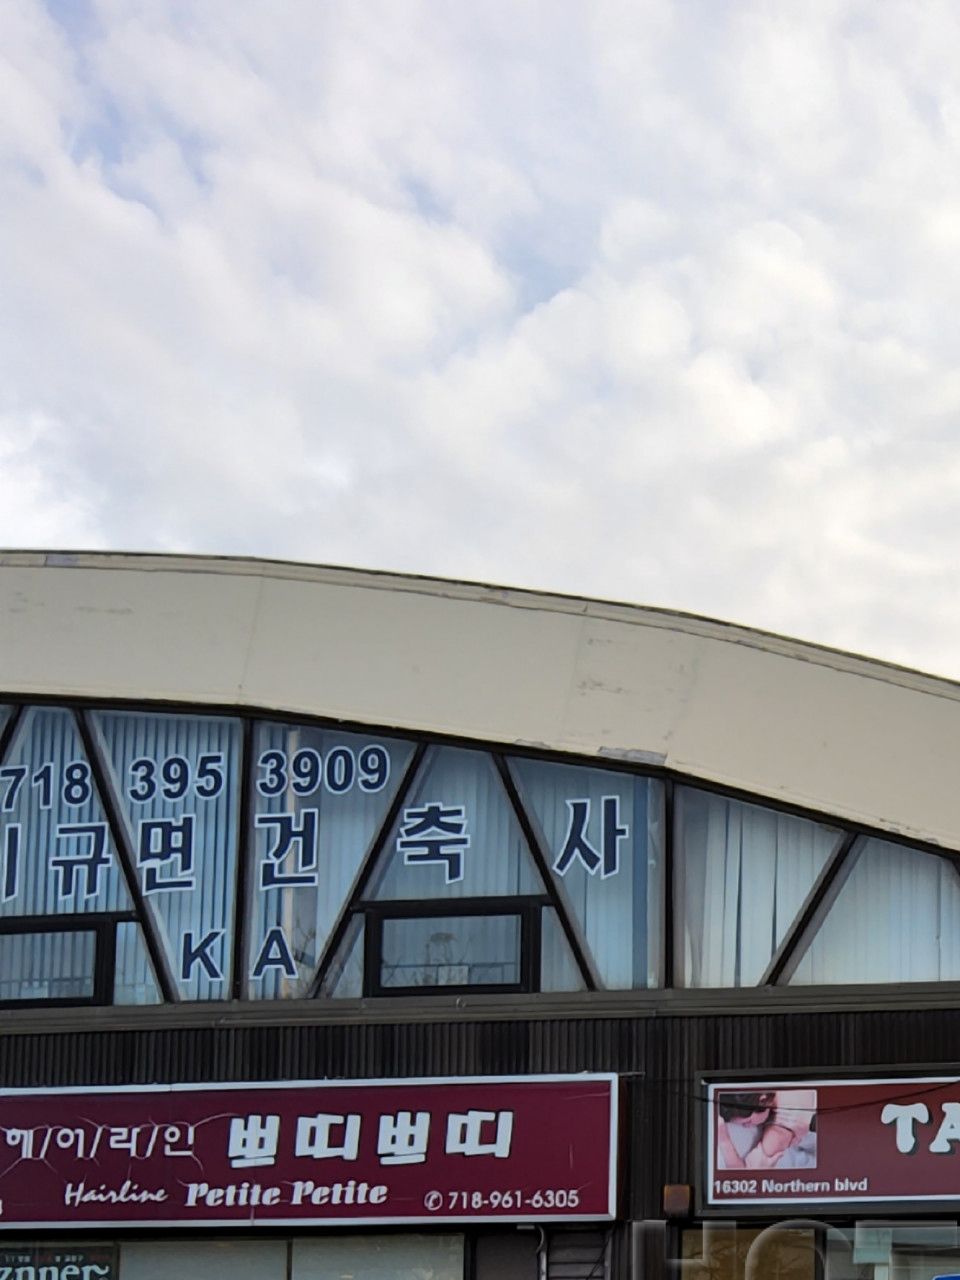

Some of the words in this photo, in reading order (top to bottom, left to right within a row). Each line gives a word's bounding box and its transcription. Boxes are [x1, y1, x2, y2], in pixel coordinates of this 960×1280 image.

[0, 761, 92, 813] 718
[128, 752, 225, 802] 395
[257, 744, 390, 796] 3909
[64, 1180, 169, 1207] Hairline
[184, 1183, 281, 1207] Petite
[290, 1179, 389, 1206] Petite
[714, 1180, 757, 1194] 16302
[762, 1178, 830, 1193] Northern
[834, 1177, 868, 1192] blvd
[447, 1189, 580, 1210] 718-961-6305
